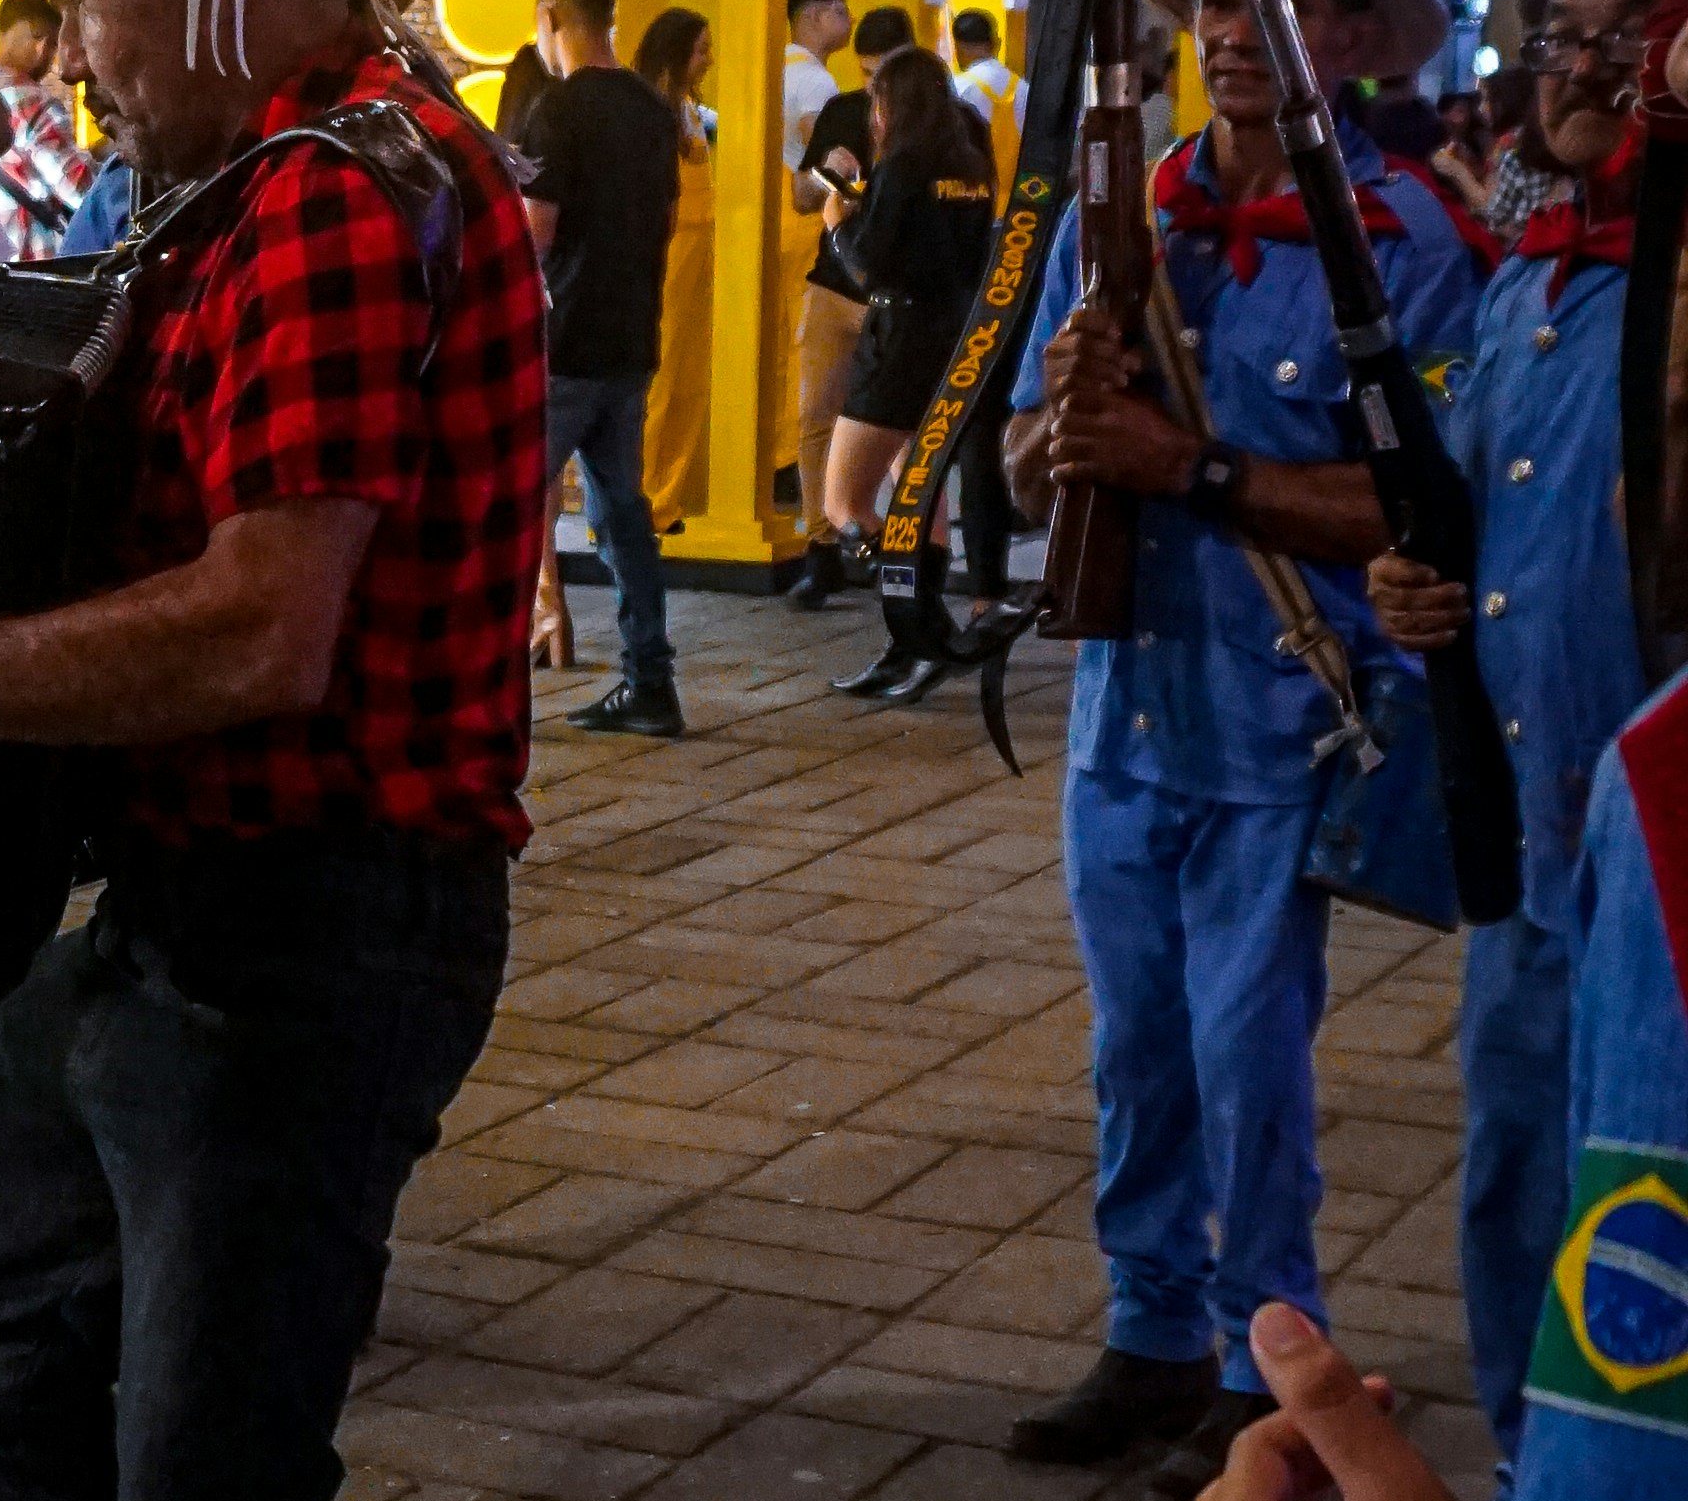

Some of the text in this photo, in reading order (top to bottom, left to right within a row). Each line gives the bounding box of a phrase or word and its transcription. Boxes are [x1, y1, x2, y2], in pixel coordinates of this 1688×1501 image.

[986, 210, 1039, 308] COSMO
[899, 399, 964, 506] MACIEL
[881, 513, 922, 553] B25
